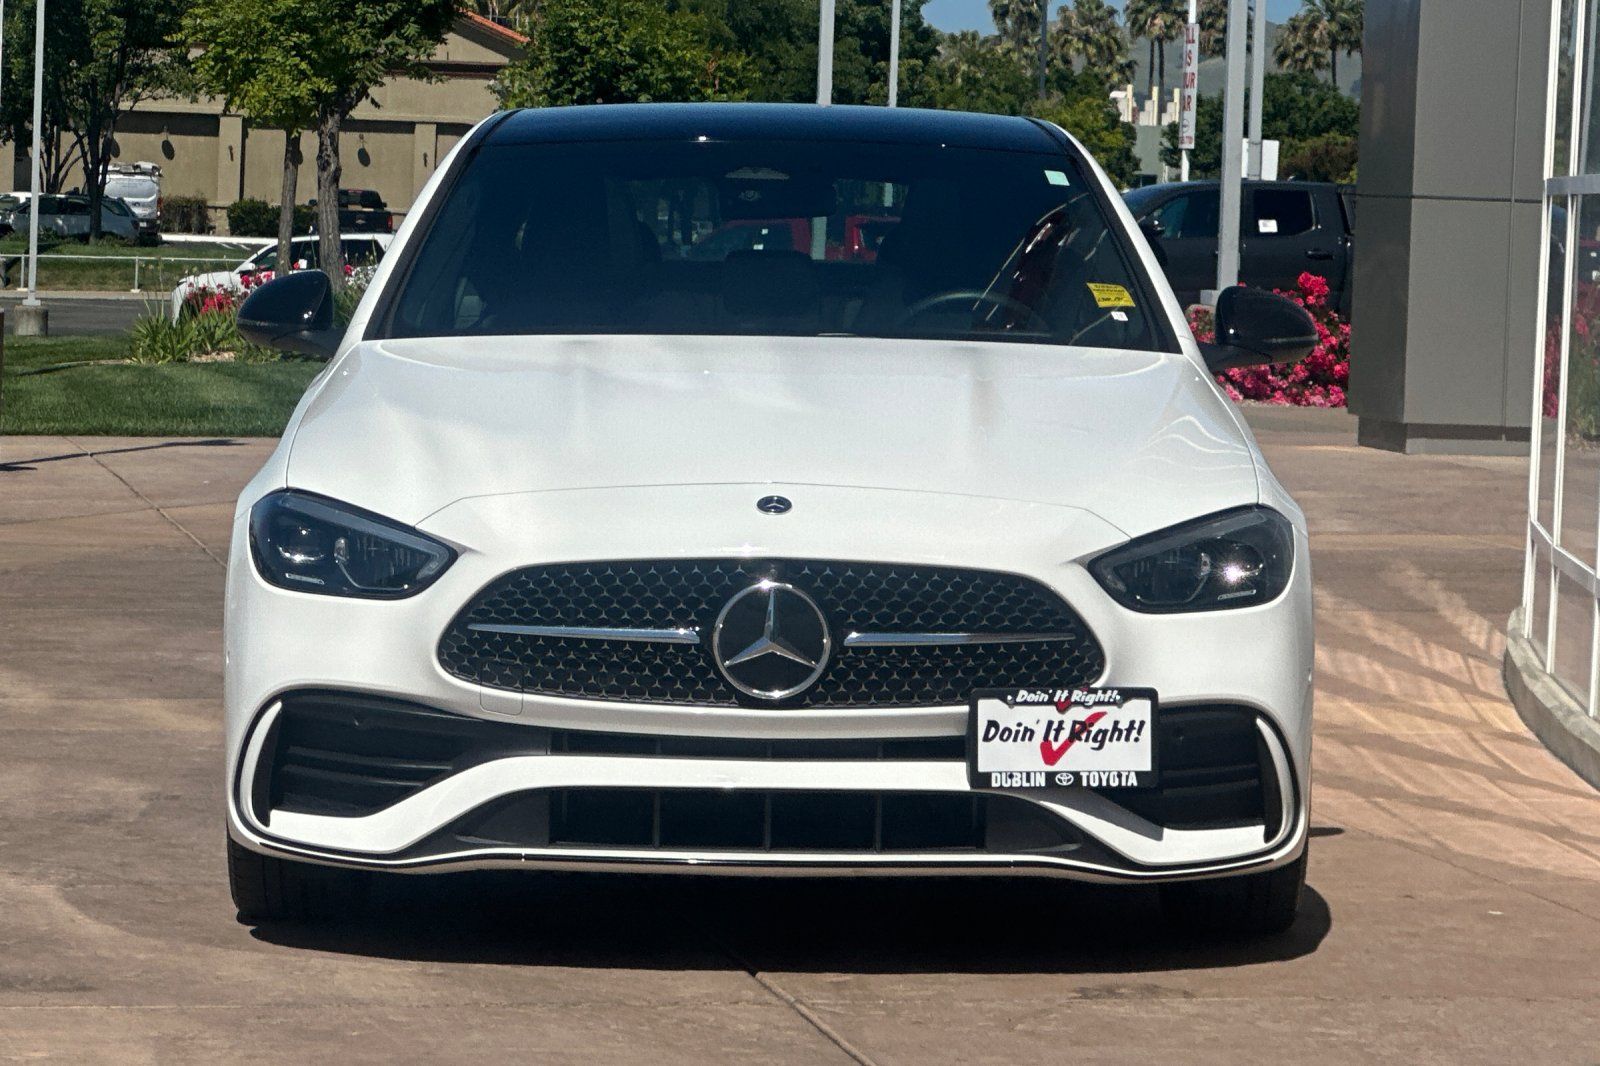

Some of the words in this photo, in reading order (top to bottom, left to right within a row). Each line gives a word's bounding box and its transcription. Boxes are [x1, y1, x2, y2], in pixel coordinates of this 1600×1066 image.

[1015, 689, 1053, 703] Doin'
[1054, 689, 1069, 703] It
[1070, 689, 1118, 706] Right!
[981, 718, 1041, 744] Doin'
[1042, 719, 1066, 743] It
[1067, 719, 1146, 751] Right!
[991, 772, 1046, 788] DUBLIN
[1080, 771, 1138, 787] TOYOTA
